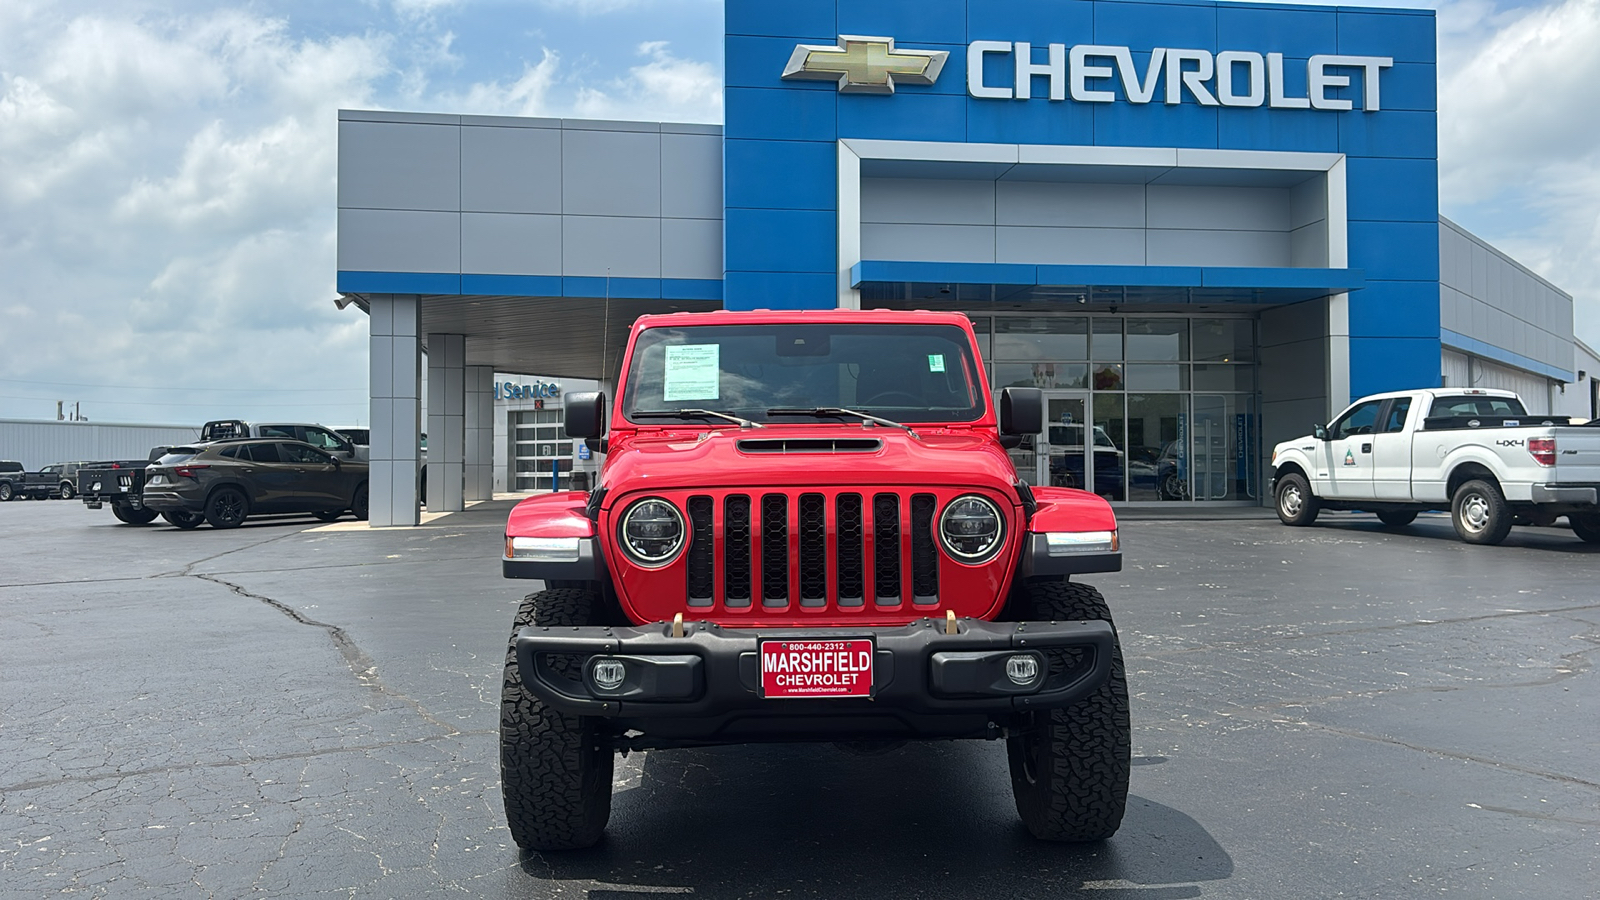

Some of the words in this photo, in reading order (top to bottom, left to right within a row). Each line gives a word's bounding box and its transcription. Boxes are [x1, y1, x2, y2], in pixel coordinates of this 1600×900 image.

[967, 40, 1394, 112] CHEVROLET
[503, 379, 558, 399] Service
[789, 643, 845, 651] 800-440-2312
[764, 651, 870, 673] MARSHFIELD
[776, 673, 859, 686] CHEVROLET
